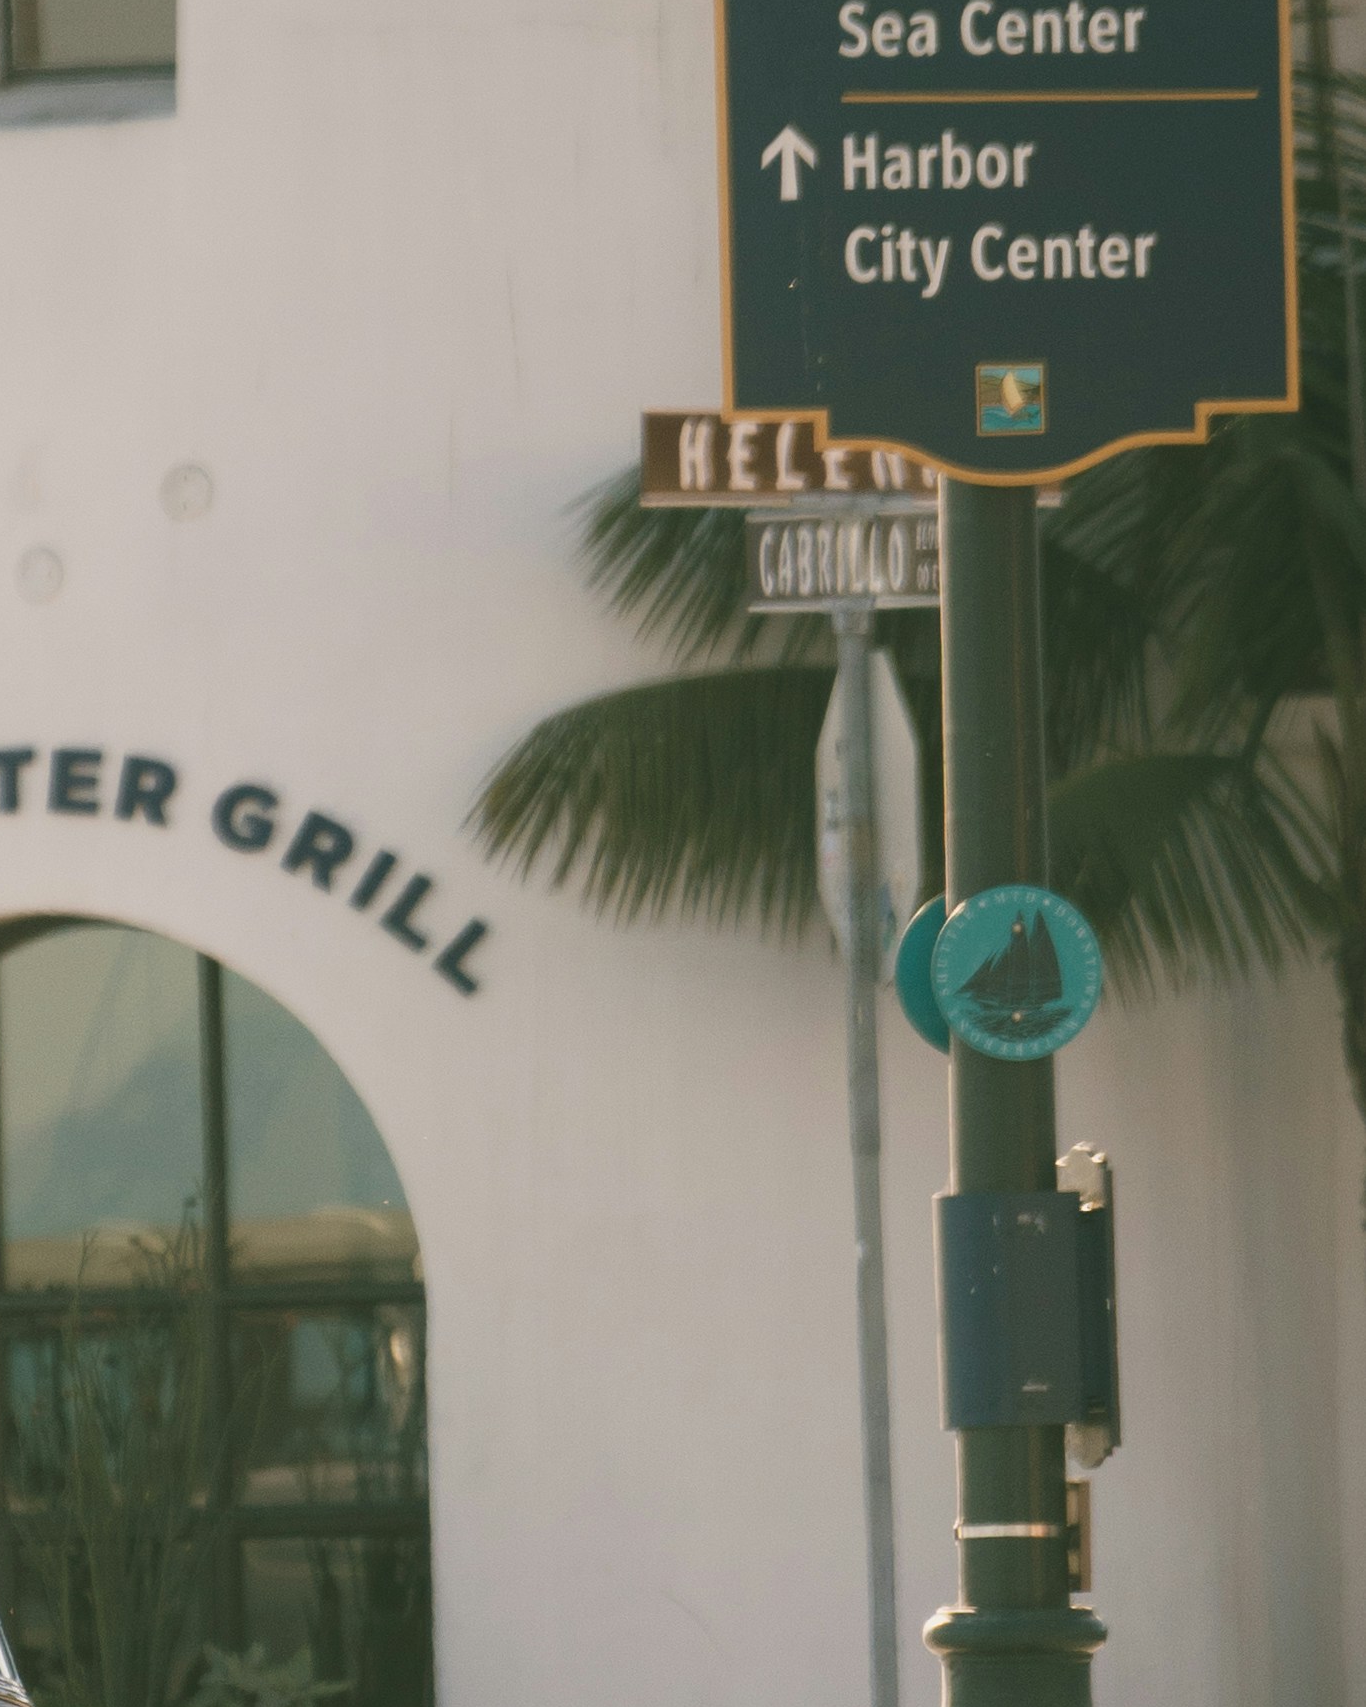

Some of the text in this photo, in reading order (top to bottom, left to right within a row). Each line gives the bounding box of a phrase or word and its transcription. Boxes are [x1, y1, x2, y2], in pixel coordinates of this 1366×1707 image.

[839, 1, 939, 58] Sea
[842, 132, 1035, 190] Harbor
[845, 225, 1156, 298] City Center
[760, 521, 908, 596] CABRILLO
[212, 781, 493, 998] GRILL
